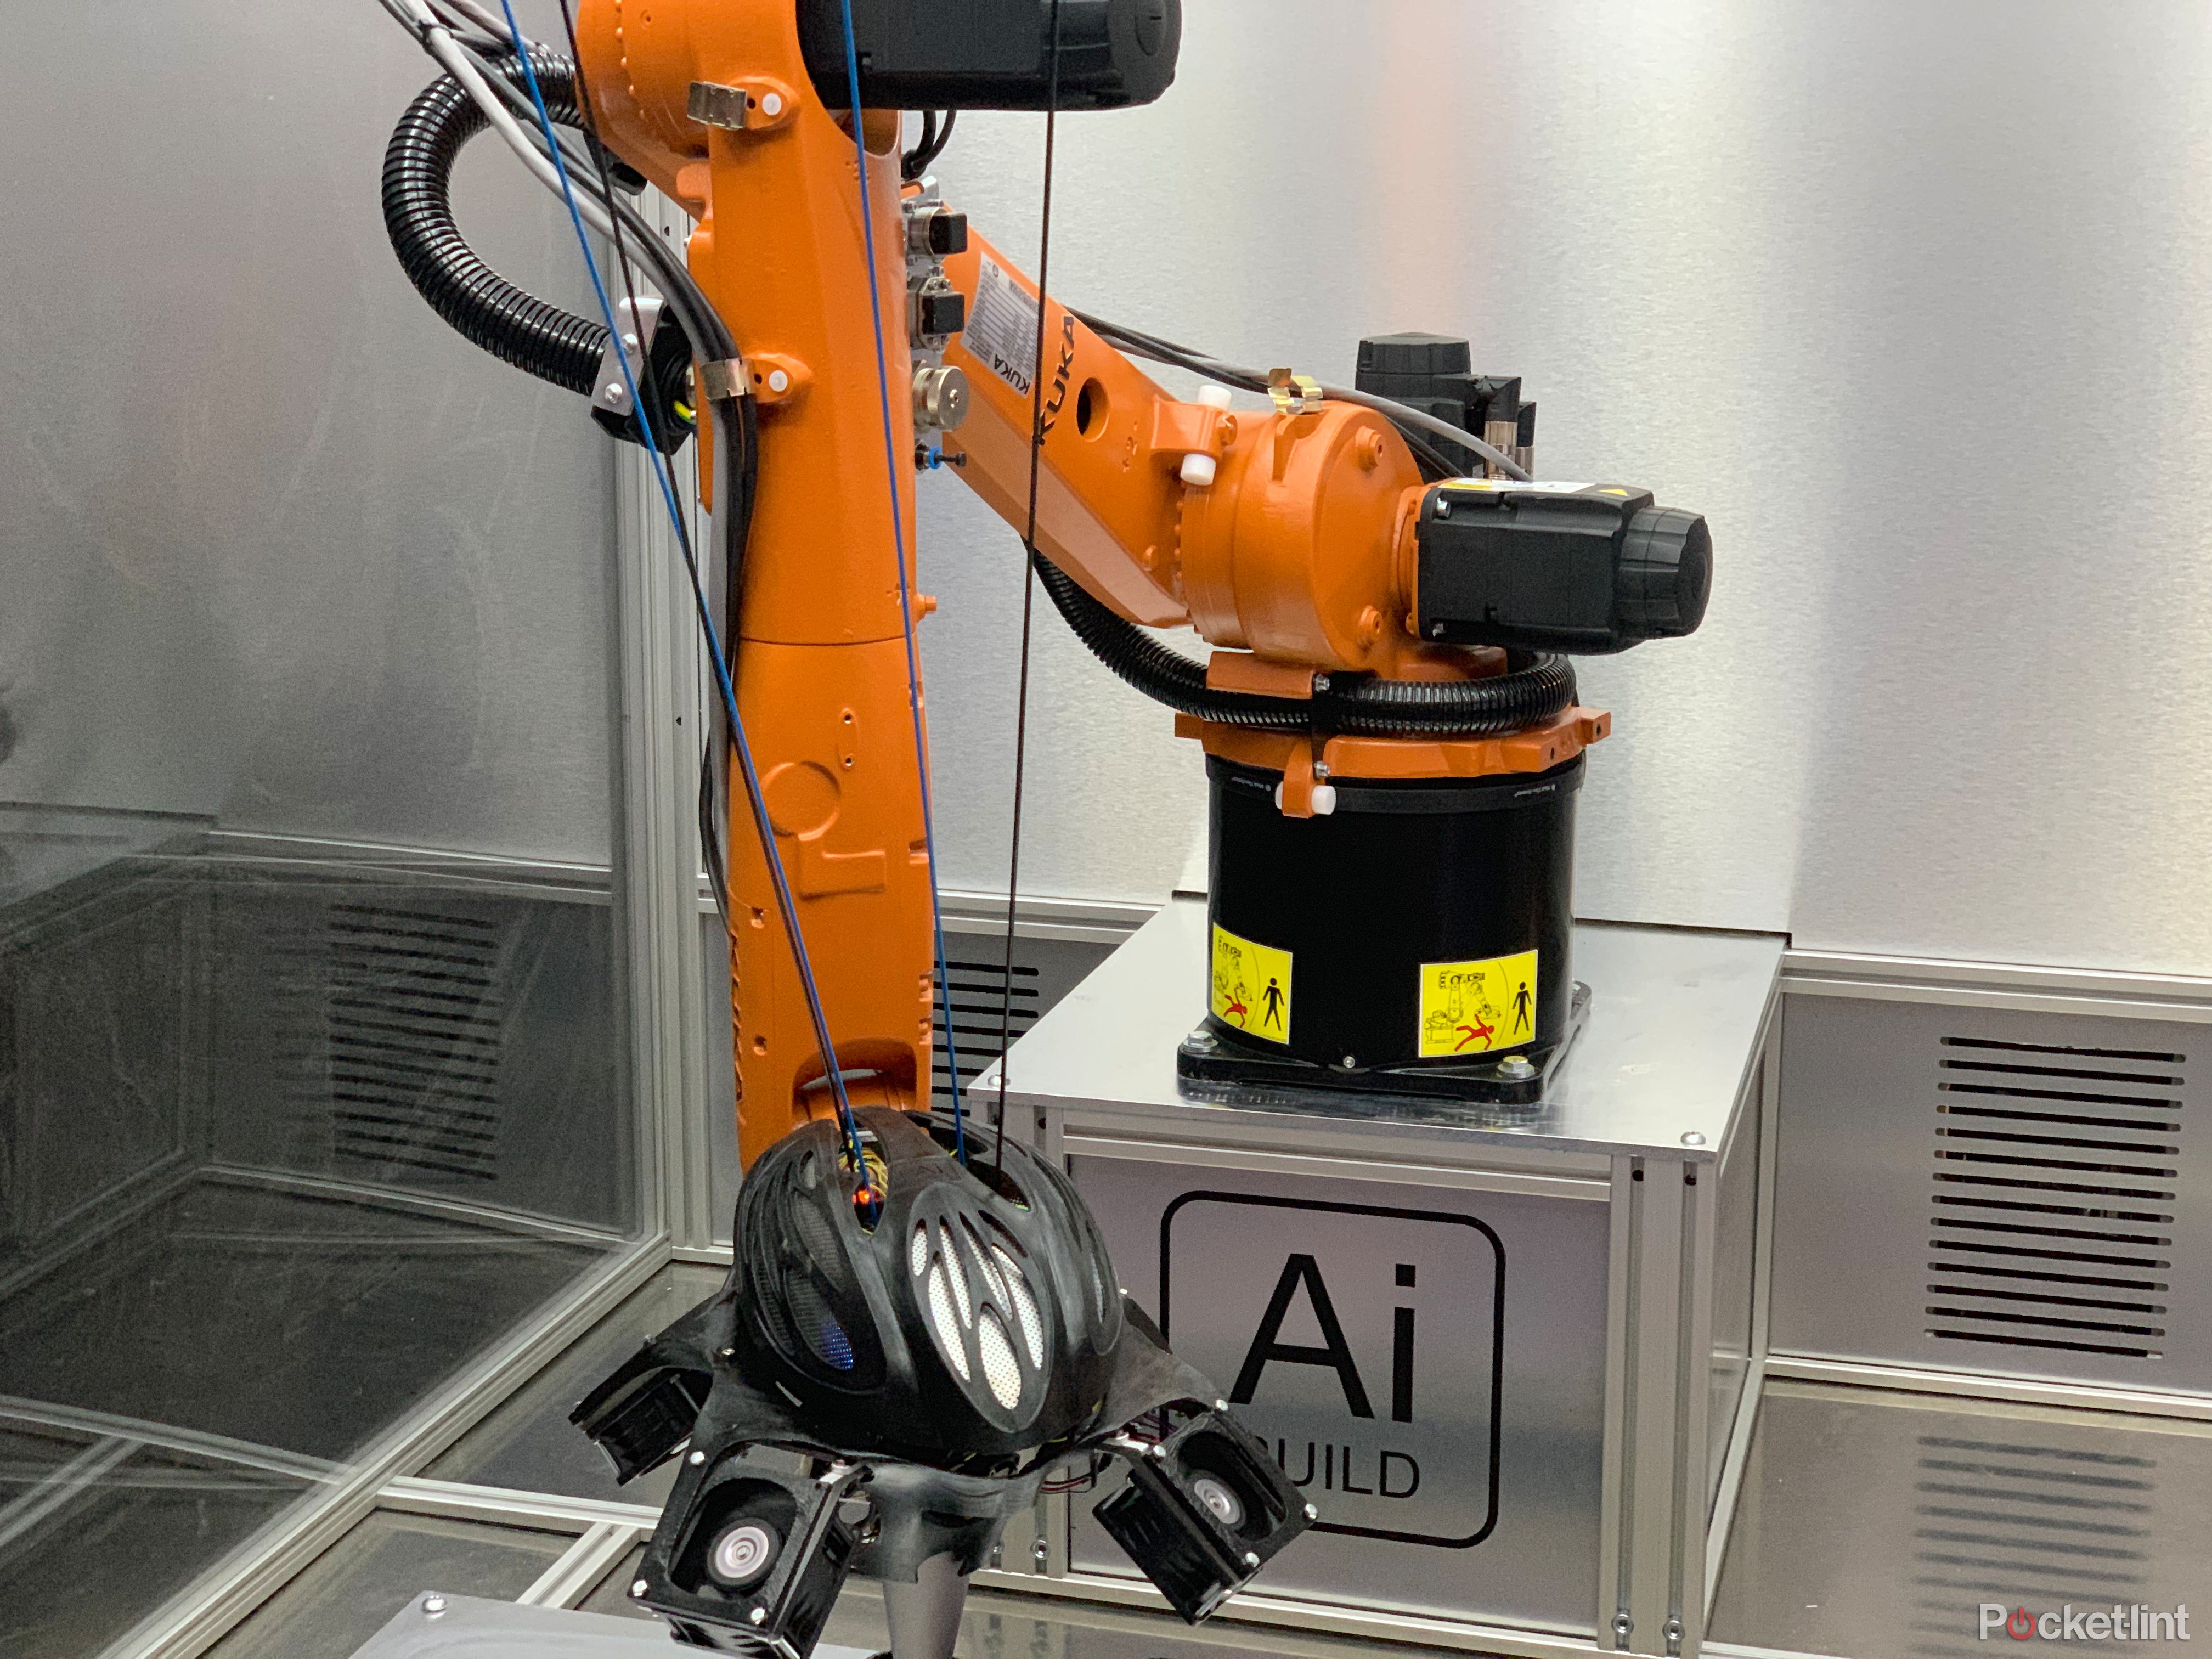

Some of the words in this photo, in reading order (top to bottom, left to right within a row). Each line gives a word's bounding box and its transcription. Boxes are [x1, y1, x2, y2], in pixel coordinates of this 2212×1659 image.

[994, 353, 1031, 395] KUKA
[1031, 315, 1075, 446] KUKA
[1228, 1253, 1417, 1424] Ai
[1255, 1436, 1420, 1499] UILD
